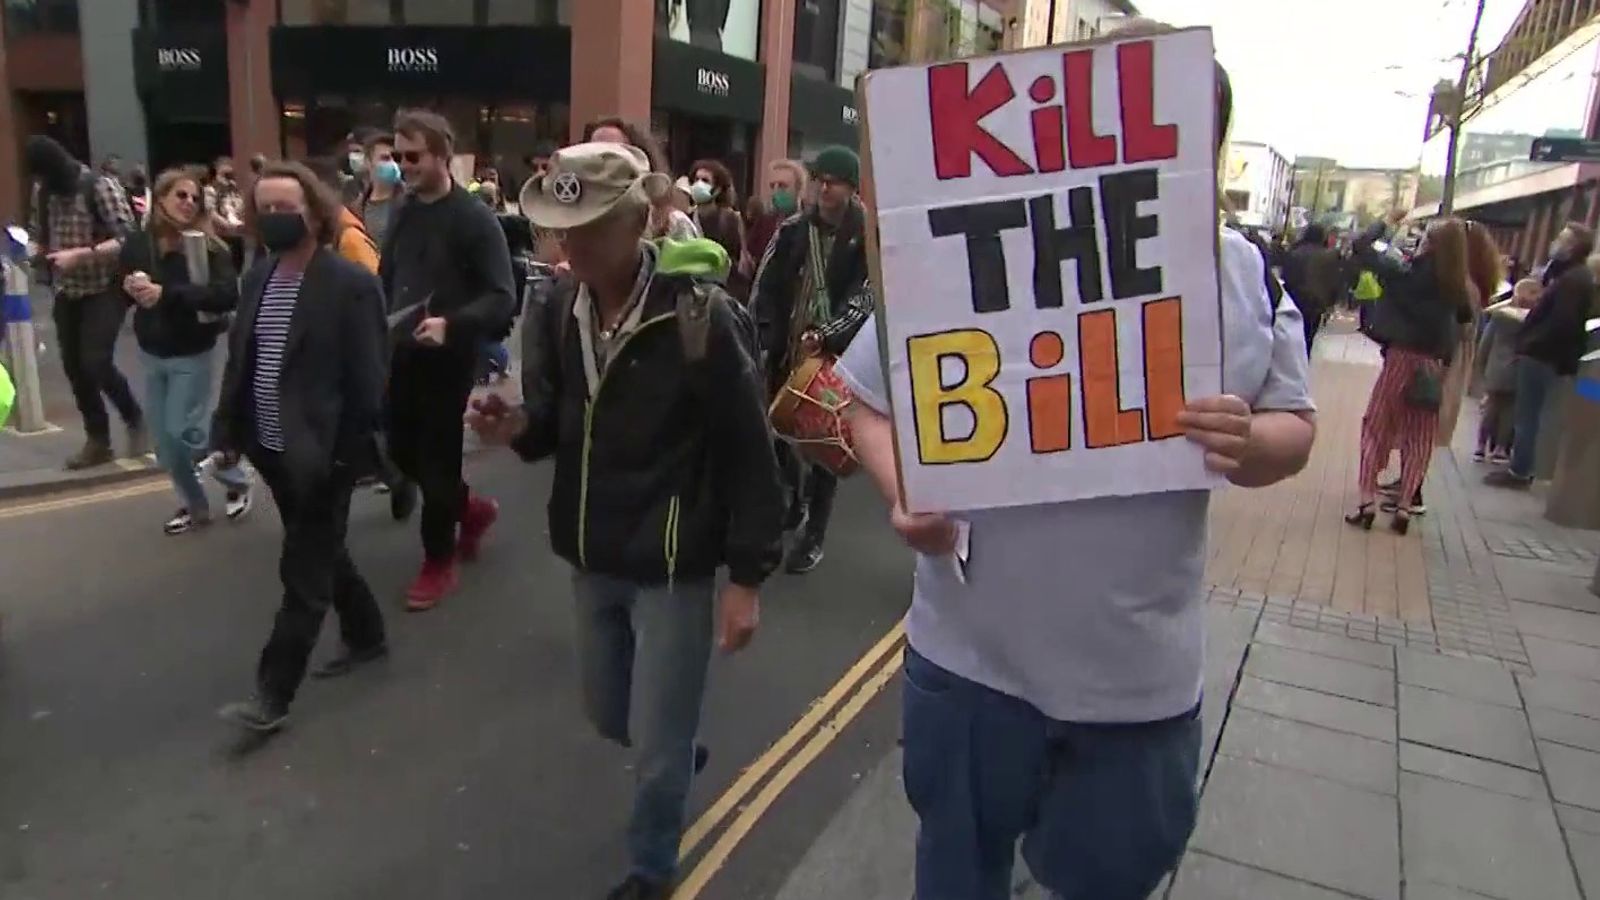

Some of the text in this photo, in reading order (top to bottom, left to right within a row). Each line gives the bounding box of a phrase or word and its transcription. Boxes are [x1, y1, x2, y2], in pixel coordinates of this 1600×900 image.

[158, 48, 201, 65] BOSS
[388, 48, 438, 65] BOSS
[697, 68, 729, 90] BOSS
[928, 168, 1163, 313] THE
